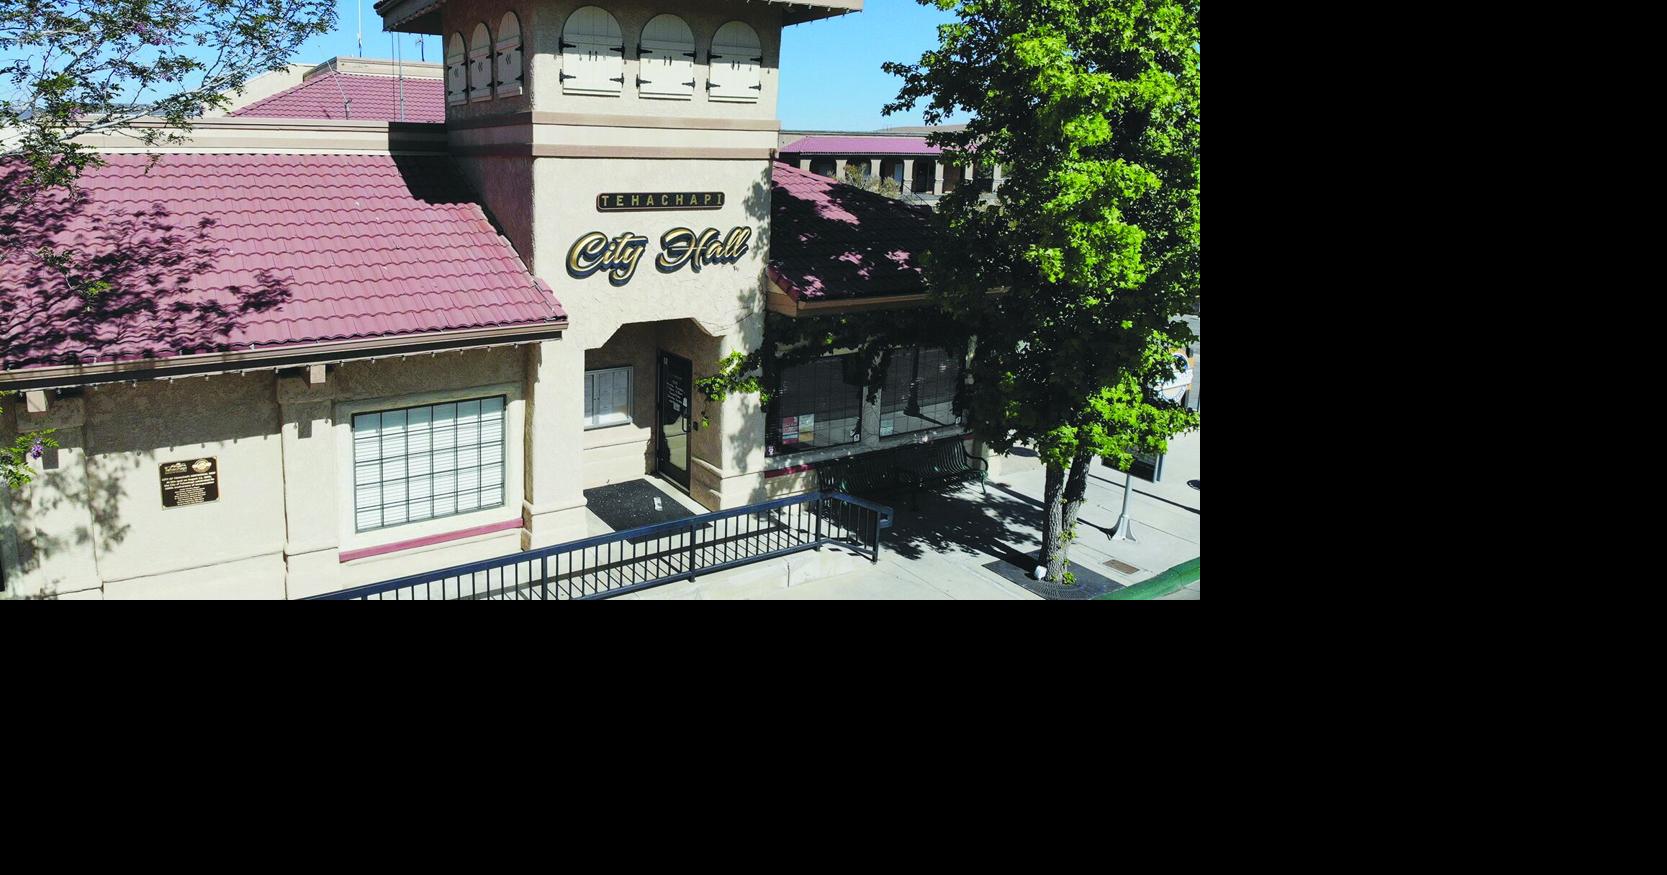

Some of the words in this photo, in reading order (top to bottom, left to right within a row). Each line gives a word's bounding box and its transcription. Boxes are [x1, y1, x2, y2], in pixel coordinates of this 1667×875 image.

[601, 194, 723, 207] TEHACHAPI
[566, 231, 649, 287] City
[655, 226, 752, 274] Hall
